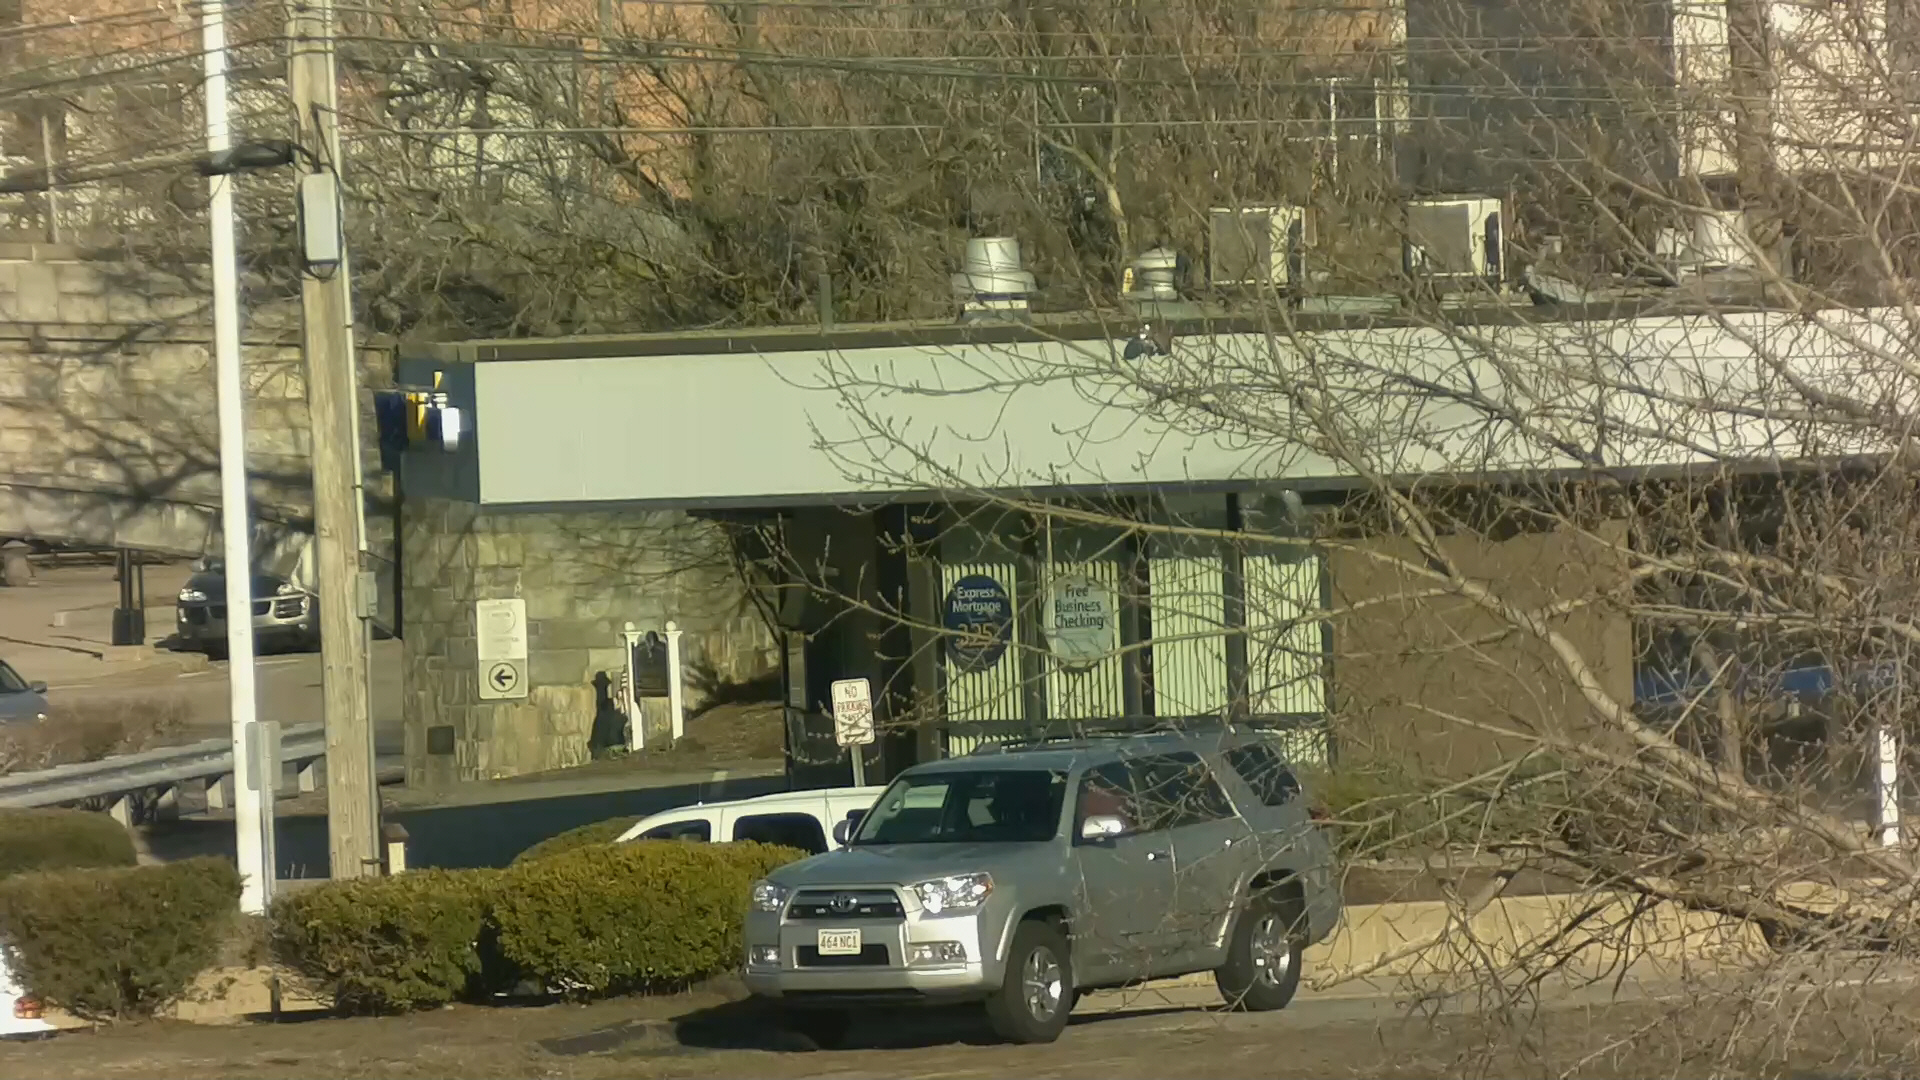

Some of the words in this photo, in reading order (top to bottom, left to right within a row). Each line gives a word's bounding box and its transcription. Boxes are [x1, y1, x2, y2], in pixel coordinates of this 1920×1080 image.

[956, 586, 994, 600] Express
[1065, 584, 1088, 598] Free
[952, 600, 1001, 615] Mortgage
[1055, 599, 1101, 612] Business
[1055, 613, 1104, 629] Checking
